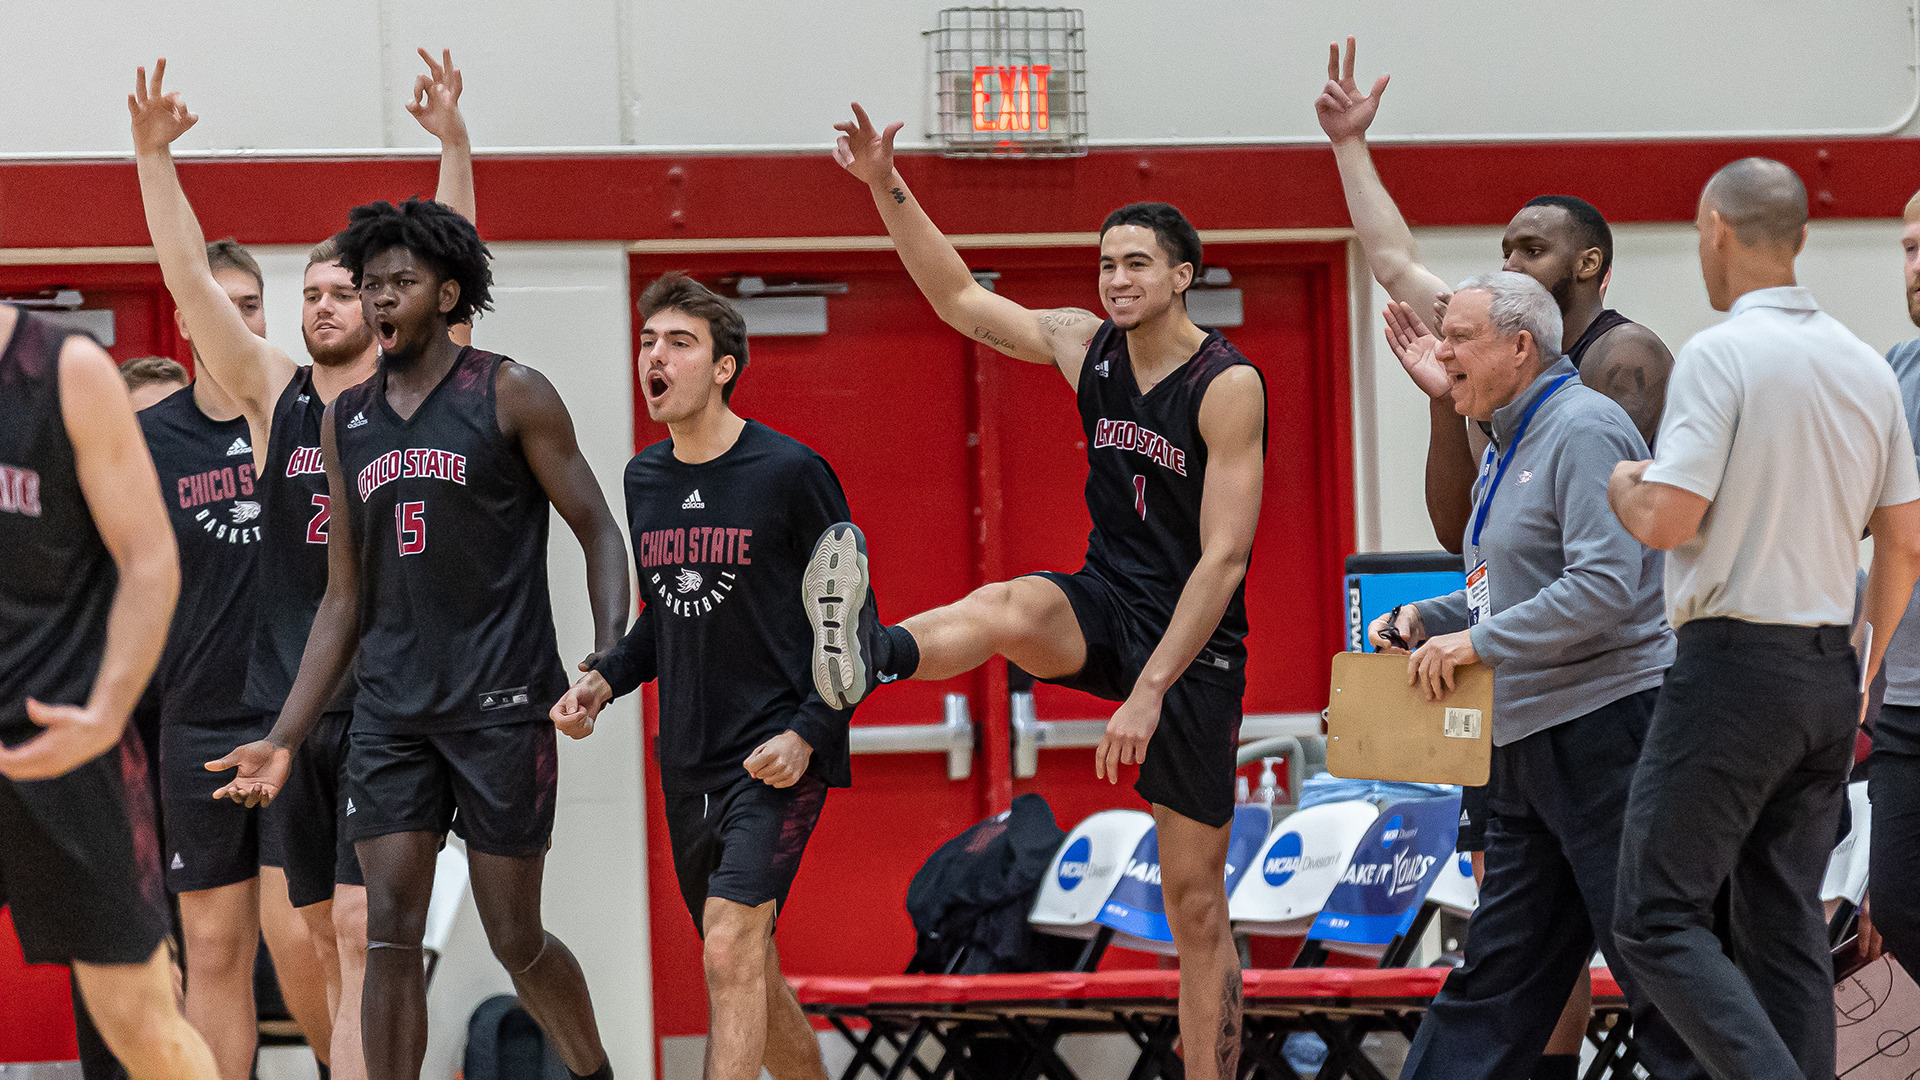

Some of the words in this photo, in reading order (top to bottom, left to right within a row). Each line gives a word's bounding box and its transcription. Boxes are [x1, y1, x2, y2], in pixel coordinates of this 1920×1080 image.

[972, 65, 1053, 131] EXIT
[346, 418, 368, 429] adidas
[286, 445, 326, 478] CHIC
[357, 449, 401, 503] CHICO
[403, 448, 466, 485] STATE
[178, 466, 236, 509] CHICO
[681, 502, 705, 510] adidas
[1133, 474, 1147, 521] 1
[394, 501, 426, 557] 15
[641, 528, 685, 568] CHICO
[689, 526, 753, 565] STATE
[651, 571, 736, 617] BASKETBALL
[1349, 588, 1362, 653] POW
